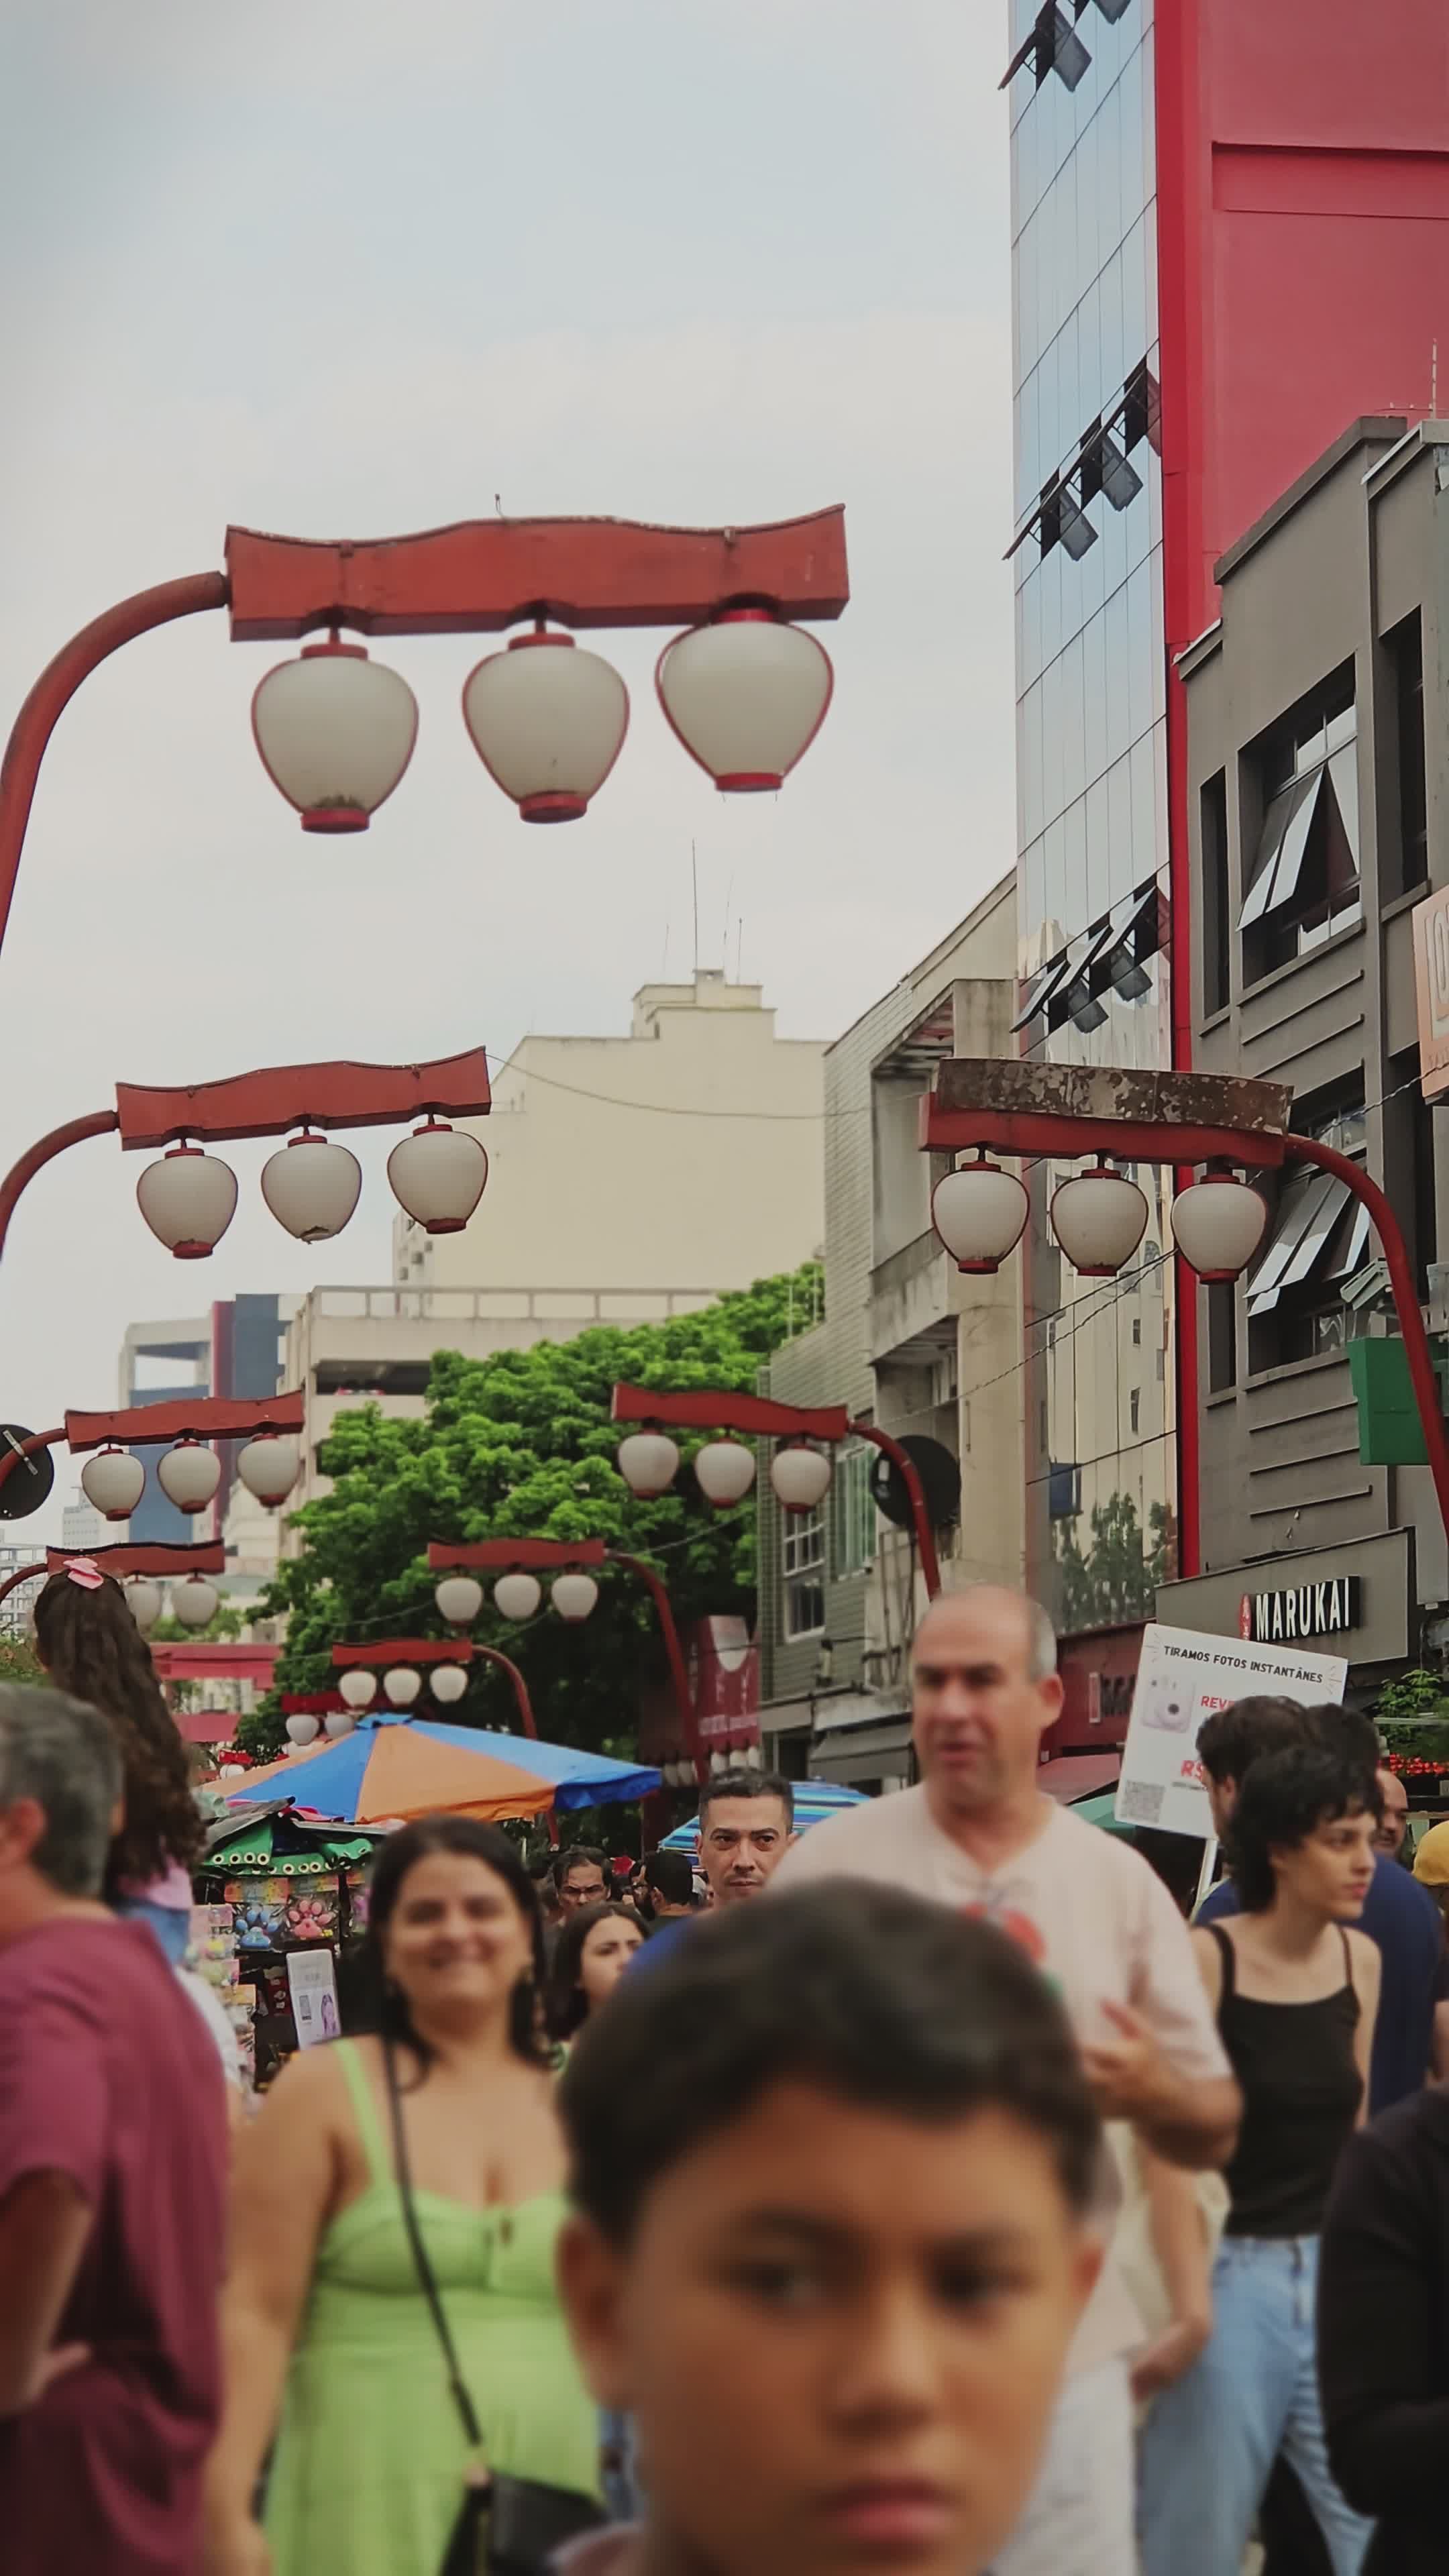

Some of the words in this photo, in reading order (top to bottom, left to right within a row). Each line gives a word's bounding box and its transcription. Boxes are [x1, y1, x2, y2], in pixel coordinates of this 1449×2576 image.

[1256, 1577, 1349, 1642] MARUKAI
[1164, 1646, 1210, 1662] TIRAMOS
[1213, 1654, 1247, 1669] FOTOS
